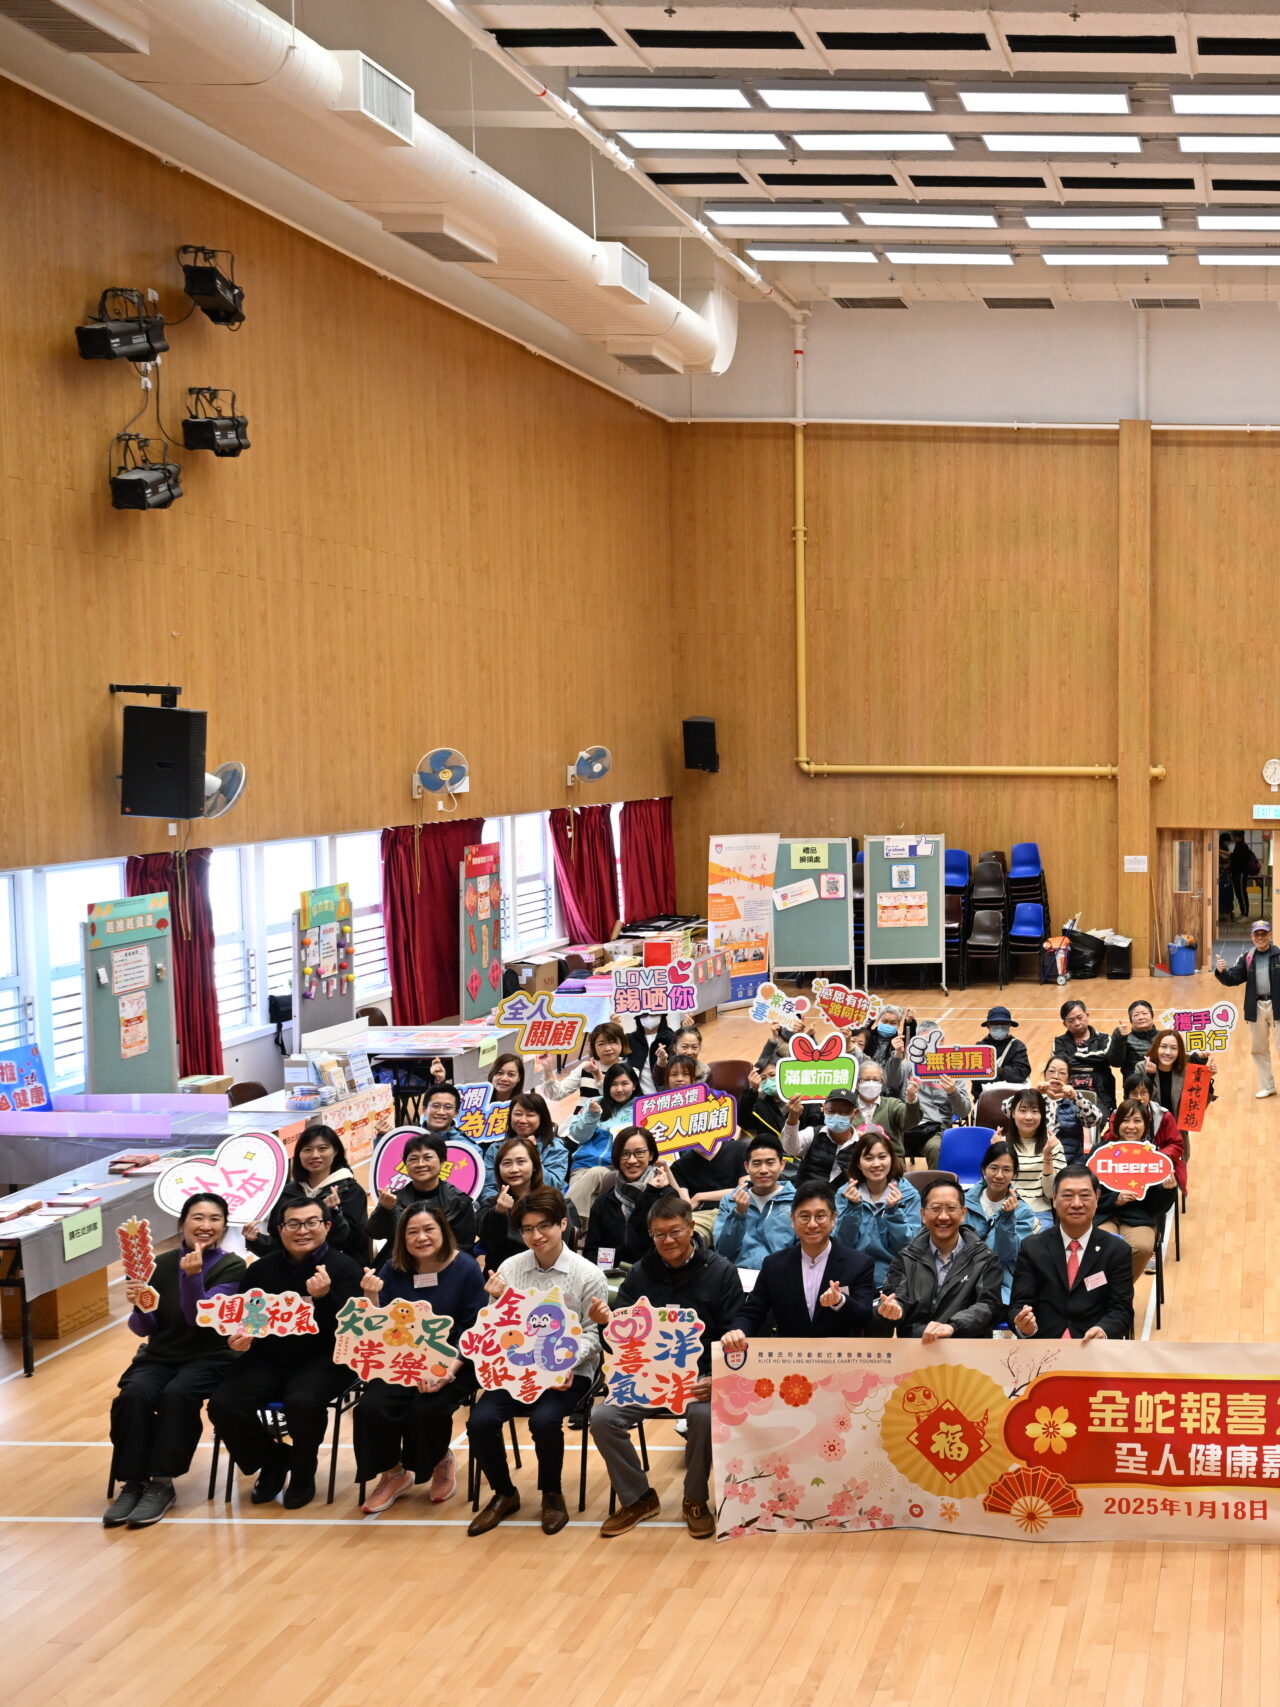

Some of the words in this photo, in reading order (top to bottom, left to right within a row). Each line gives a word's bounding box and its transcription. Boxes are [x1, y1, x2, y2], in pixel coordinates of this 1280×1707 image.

[1256, 807, 1272, 817] EXIT
[614, 969, 667, 987] LOVE
[503, 999, 547, 1021] 全人
[820, 988, 871, 1010] 感恩有你
[820, 1002, 866, 1023] 一路同行
[524, 1020, 578, 1047] 關顧
[1186, 1029, 1228, 1052] 同行
[925, 1051, 984, 1071] 無得頂
[784, 1068, 849, 1085] 滿載而歸
[641, 1088, 699, 1115] 矜憫為懷
[650, 1107, 729, 1143] 全人關顧
[1096, 1159, 1164, 1174] Cheers!
[180, 1167, 248, 1198] 以人
[199, 1296, 318, 1334] 一團和氣
[658, 1310, 695, 1323] 2025
[338, 1303, 459, 1357] 知足
[461, 1287, 543, 1404] 金蛇報喜
[349, 1341, 428, 1385] 常樂
[1088, 1389, 1267, 1436] 金蛇報喜
[930, 1420, 970, 1462] 福
